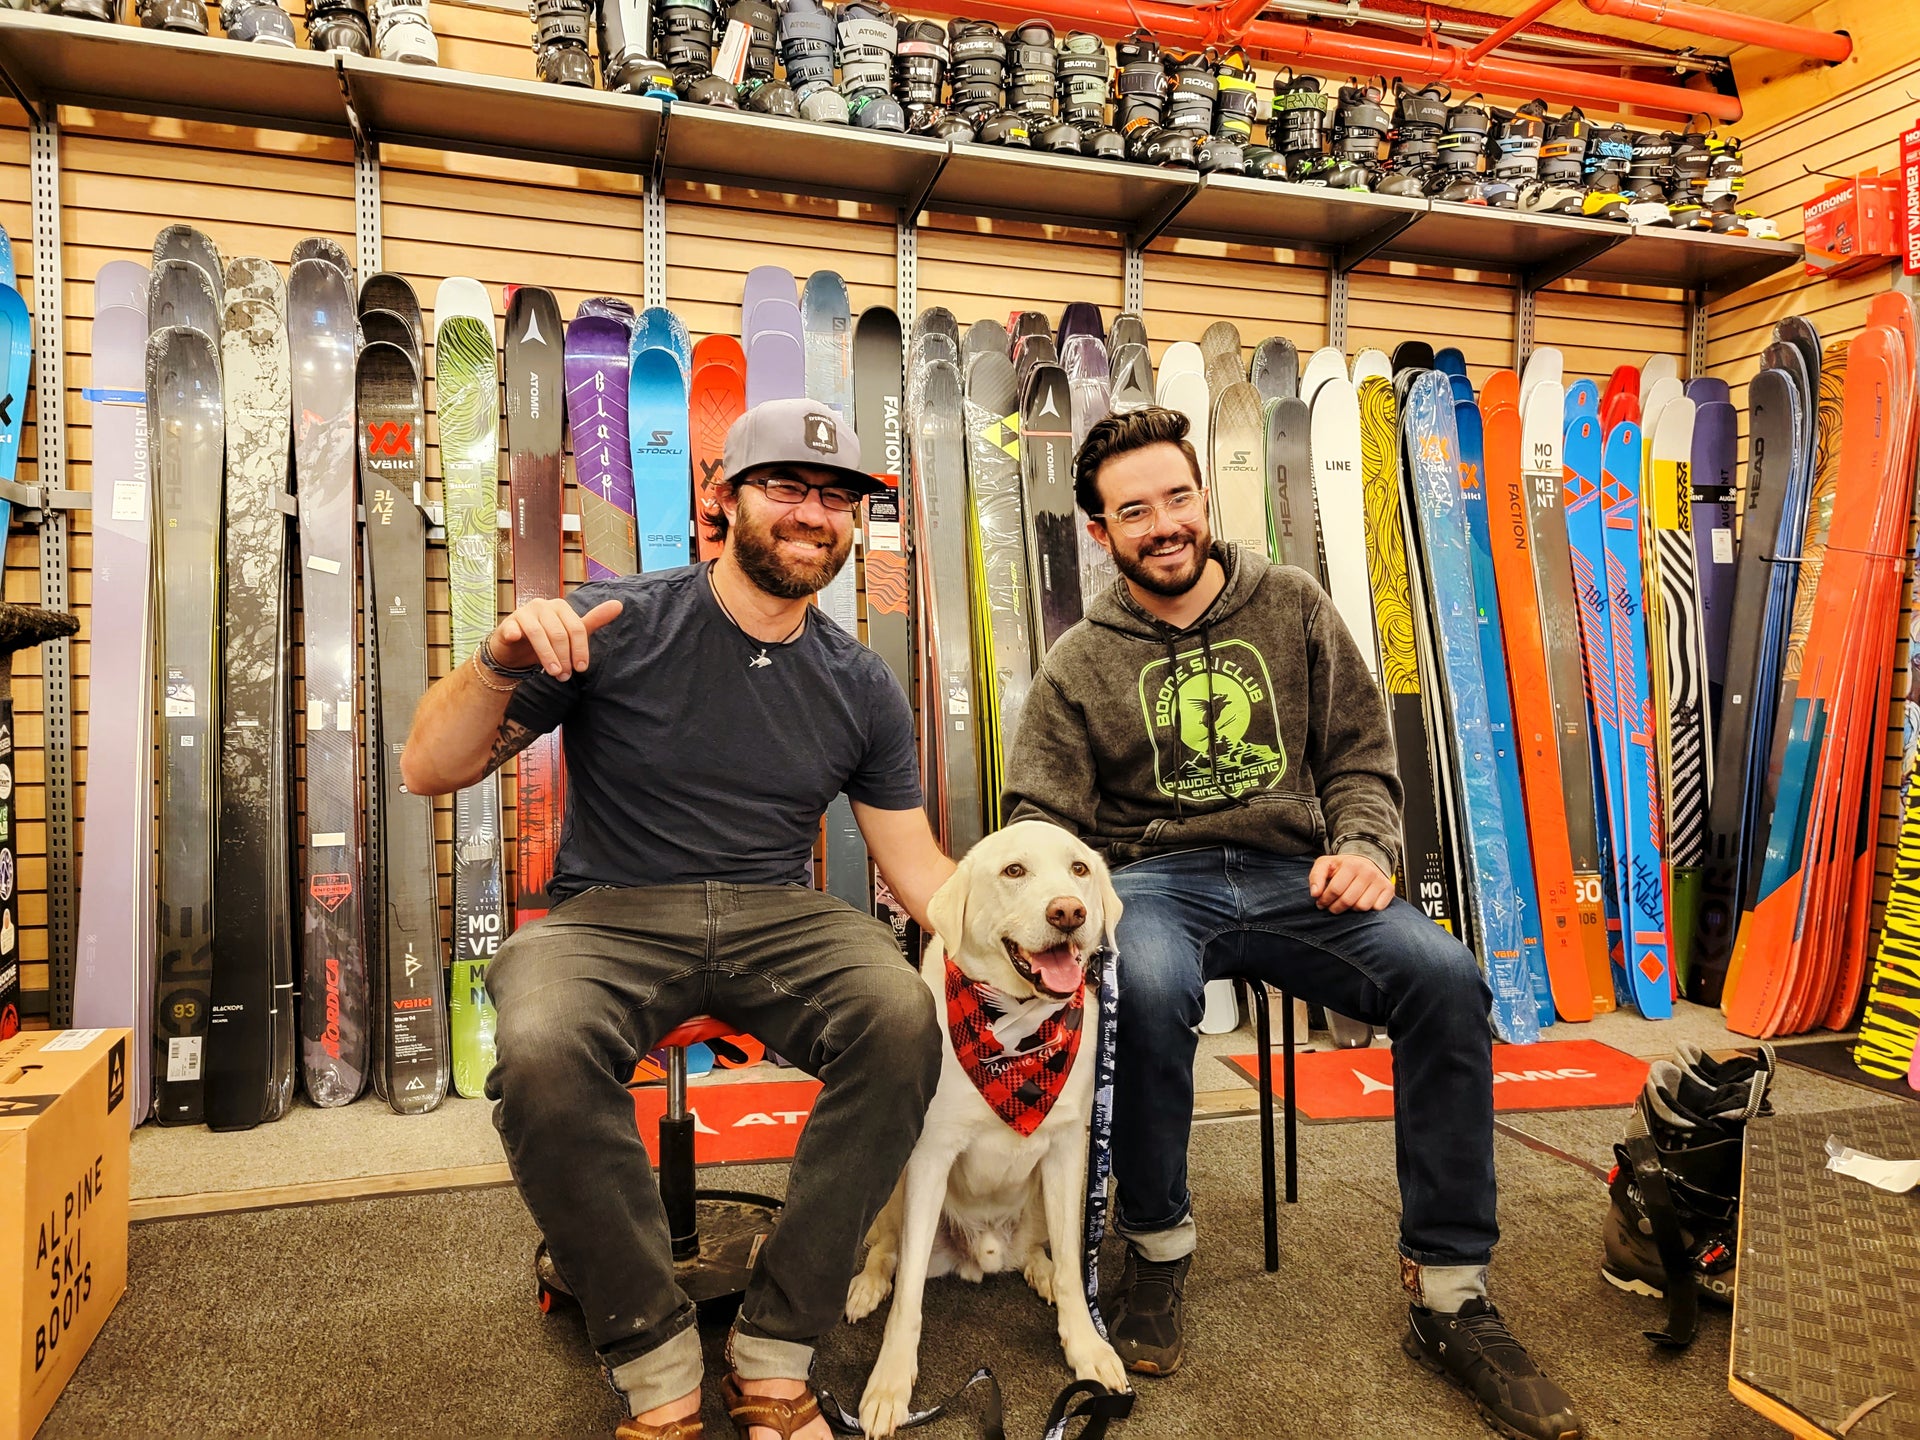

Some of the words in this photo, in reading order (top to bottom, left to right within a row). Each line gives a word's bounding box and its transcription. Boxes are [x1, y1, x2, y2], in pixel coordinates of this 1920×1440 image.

[789, 21, 821, 31] ATOMIC
[857, 27, 888, 41] ATOMIC
[1804, 187, 1854, 219] HOTRONIC
[1906, 164, 1919, 230] WARMER
[1908, 233, 1920, 269] FOOT
[529, 371, 540, 419] ATOMIC
[134, 407, 147, 481] AUGMENT
[883, 395, 901, 475] FACTION
[369, 459, 414, 470] Völkl
[1046, 441, 1056, 485] ATOMIC
[1325, 460, 1351, 471] LINE
[1748, 437, 1765, 510] HEAD
[1277, 464, 1293, 537] HEAD
[1507, 482, 1527, 550] FACTION
[1721, 468, 1730, 528] AUGNT
[1010, 560, 1021, 617] FISCHER
[1583, 584, 1608, 613] 106
[1614, 587, 1638, 617] 106
[1222, 660, 1264, 704] CLUB
[1224, 761, 1280, 782] CHASING
[173, 1003, 196, 1018] 93
[212, 1004, 244, 1012] BLACKOPS
[320, 958, 340, 1060] NORDICA
[36, 1154, 103, 1270] ALPINE
[50, 1227, 81, 1300] SKI
[35, 1260, 92, 1374] BOOTS
